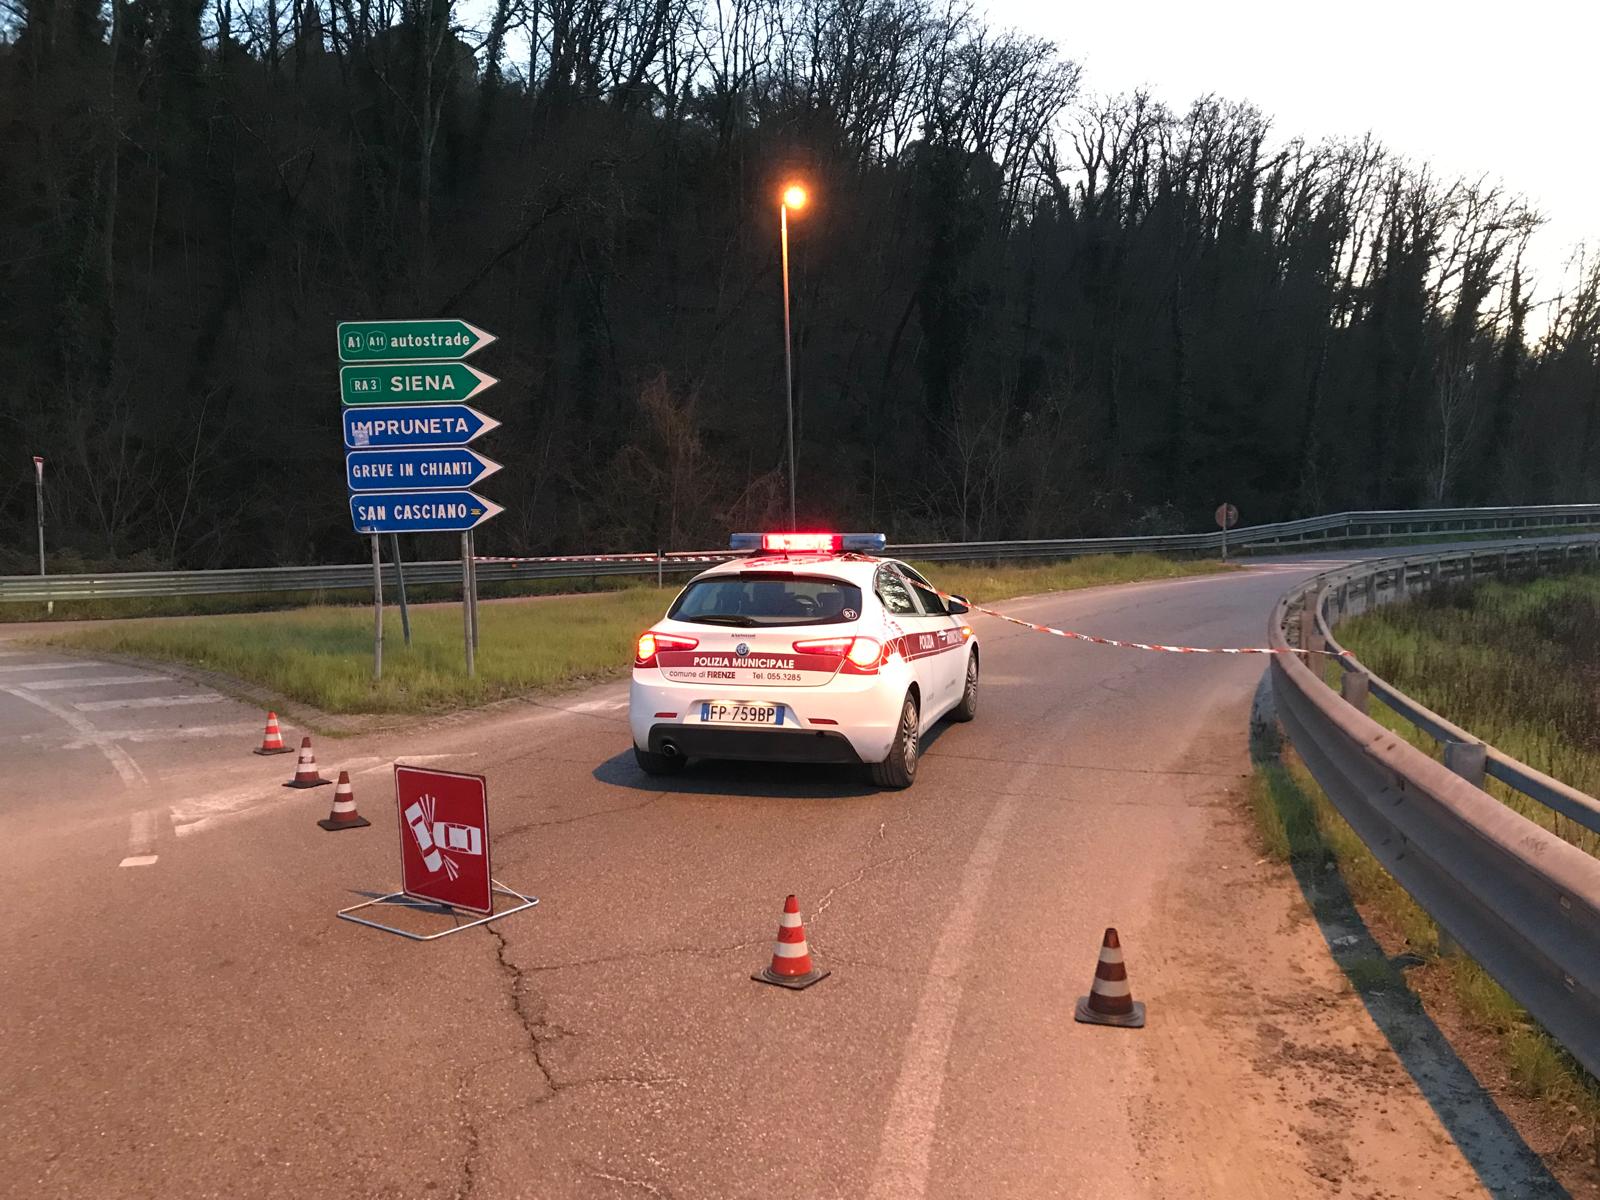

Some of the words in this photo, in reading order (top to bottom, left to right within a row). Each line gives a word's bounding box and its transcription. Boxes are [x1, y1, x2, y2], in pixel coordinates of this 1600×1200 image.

[347, 336, 361, 348] A1
[369, 335, 384, 346] A11
[390, 332, 470, 348] autostrade
[390, 375, 455, 392] SIENA
[351, 417, 469, 436] IMPRUNETA
[352, 464, 394, 478] GREVE
[400, 463, 414, 477] IN
[420, 462, 472, 476] CHIANTI
[358, 505, 386, 521] SAN
[394, 503, 467, 520] CASCIANO
[693, 657, 730, 667] POLIZIA
[732, 658, 795, 669] MUNICIPALE
[669, 670, 697, 678] comune
[706, 671, 736, 679] FIRENZE
[767, 672, 801, 682] 055.3285
